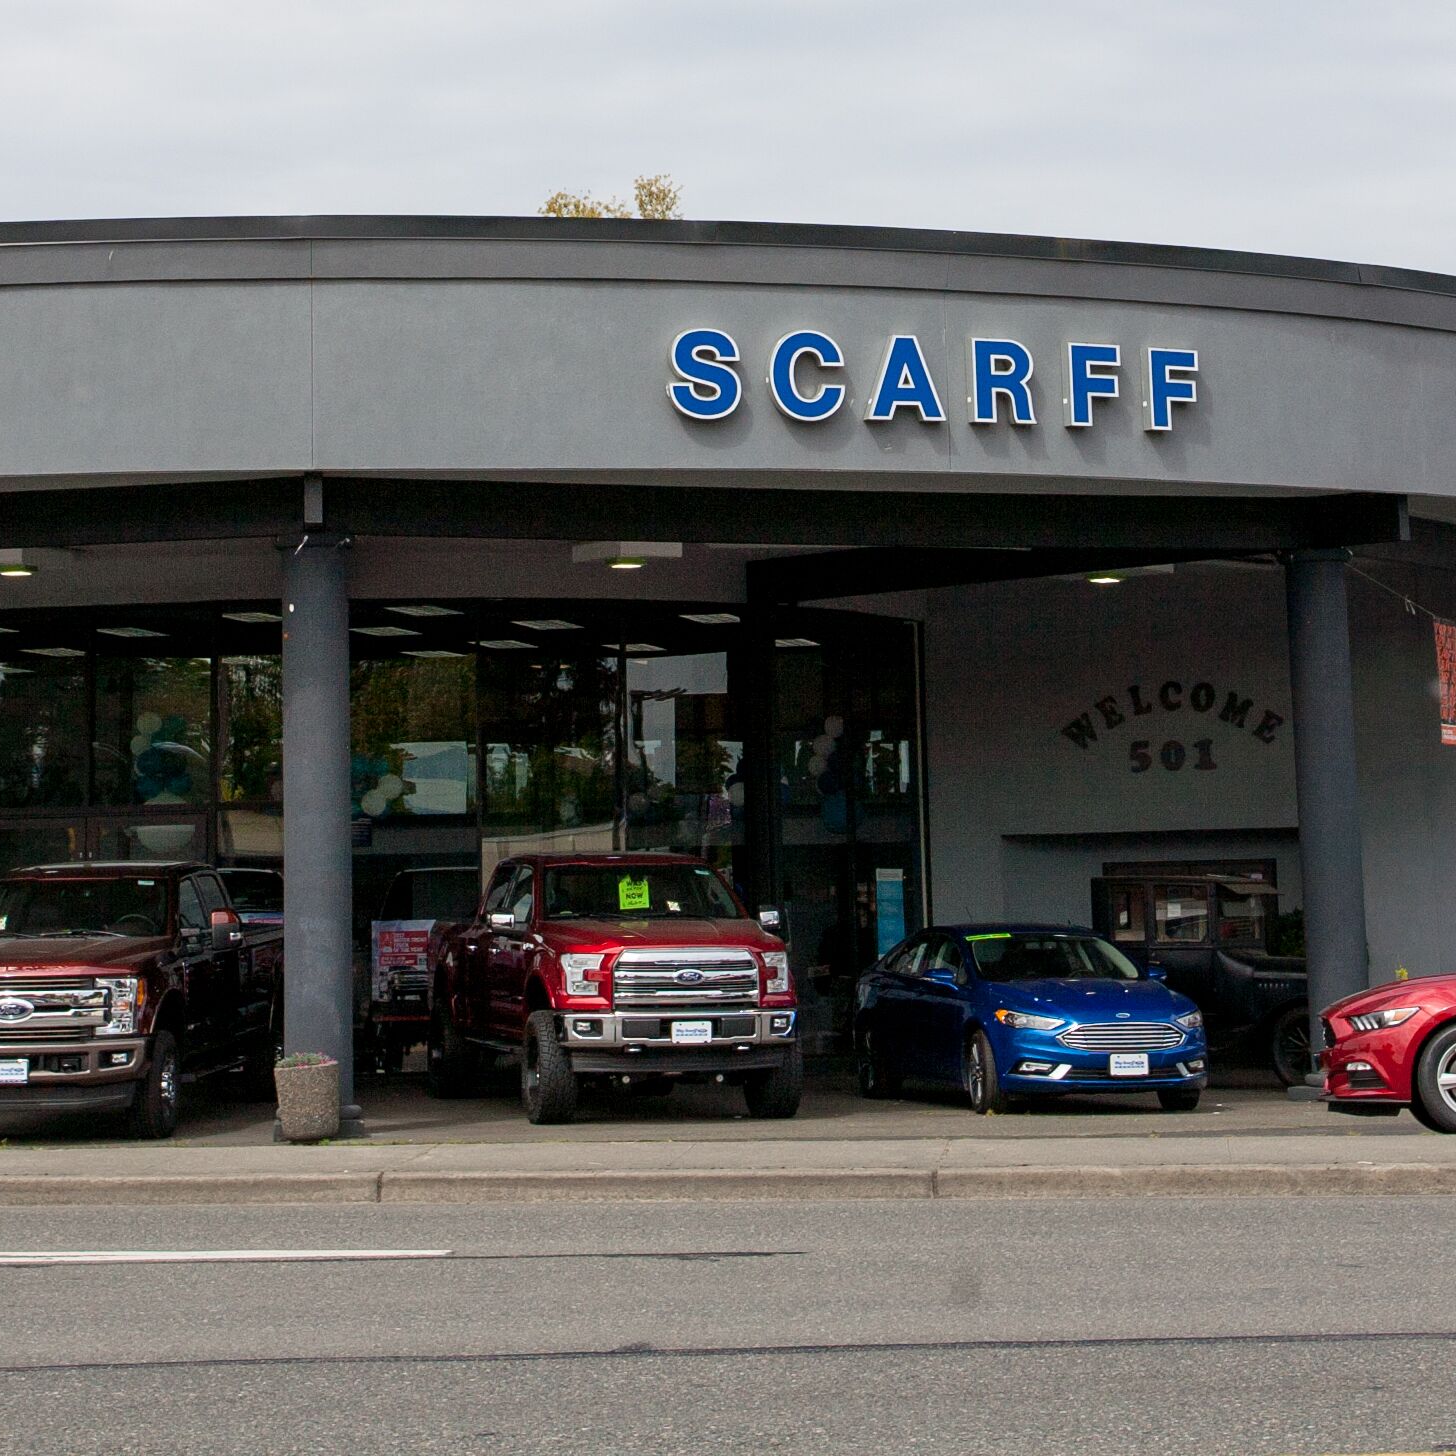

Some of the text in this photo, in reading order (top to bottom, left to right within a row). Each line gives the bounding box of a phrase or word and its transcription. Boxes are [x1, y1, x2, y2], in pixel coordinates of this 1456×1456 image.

[665, 328, 1200, 432] SCARFF
[1059, 680, 1285, 748] WELCOME
[1129, 739, 1218, 774] 501
